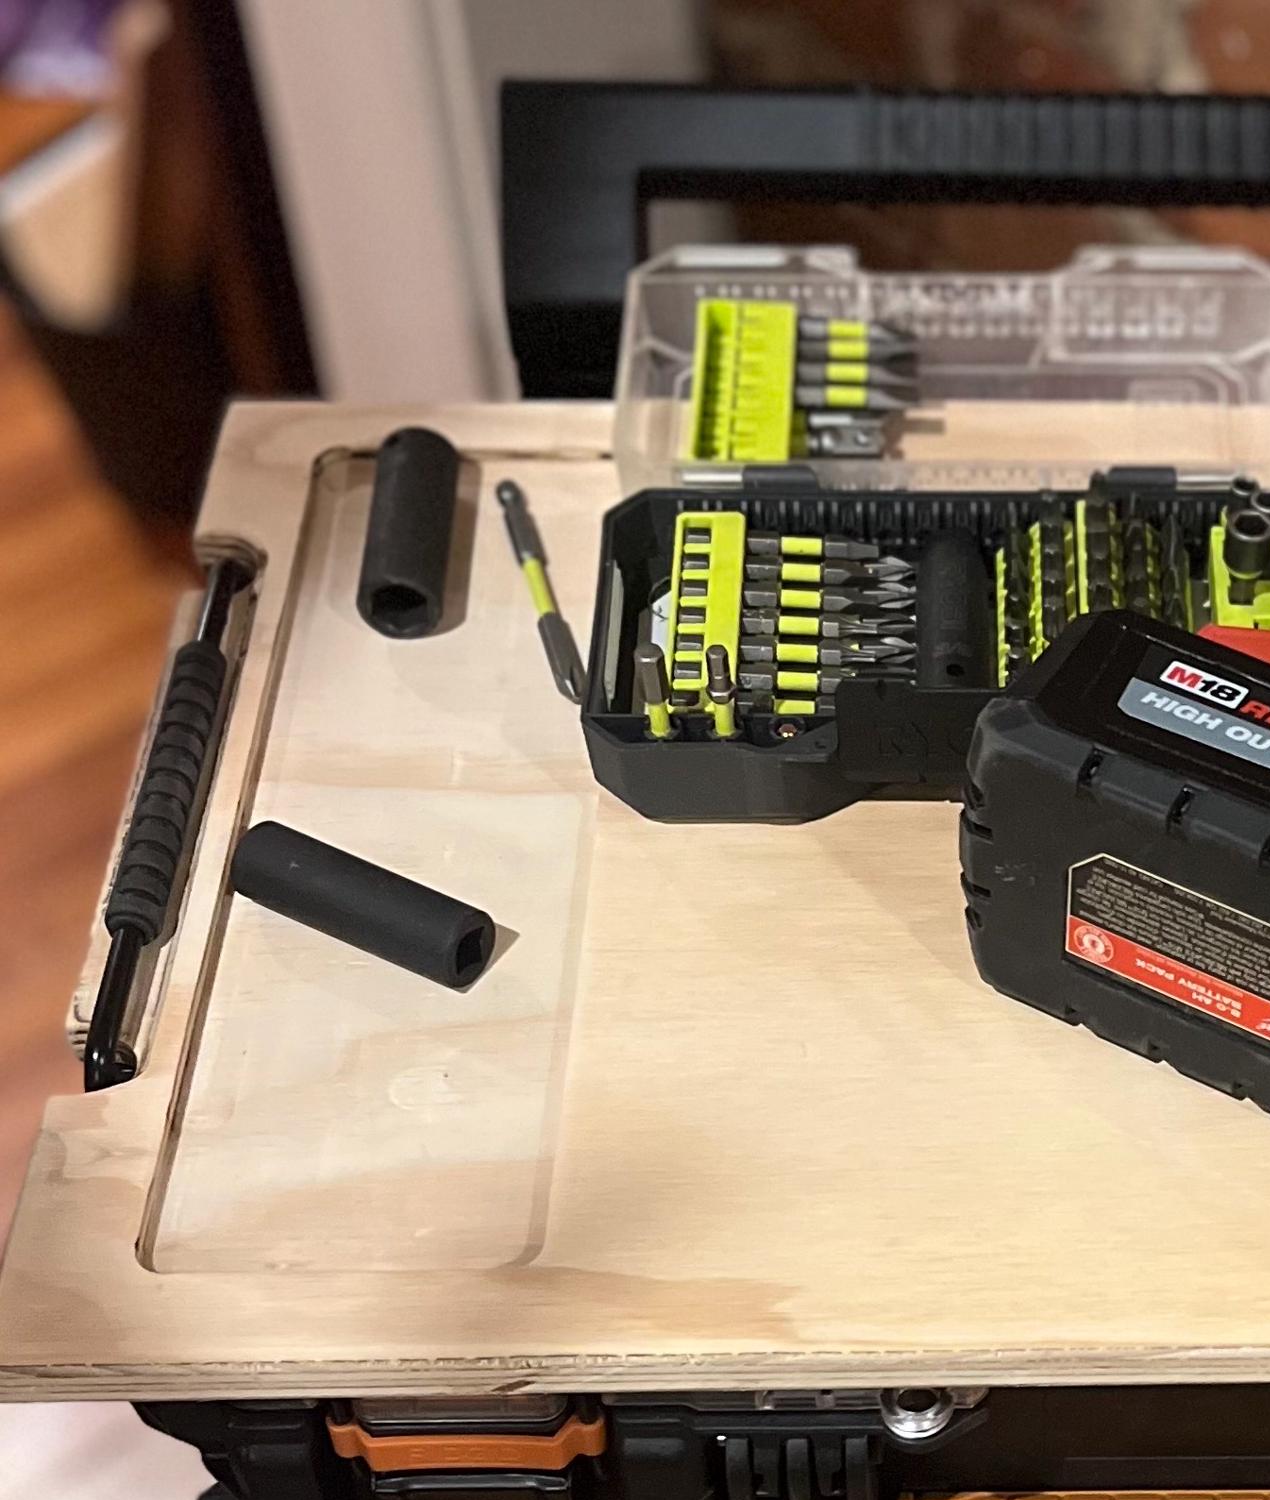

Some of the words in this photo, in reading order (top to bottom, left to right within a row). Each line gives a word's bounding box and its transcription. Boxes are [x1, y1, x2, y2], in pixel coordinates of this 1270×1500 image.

[1166, 665, 1242, 702] M18
[1140, 691, 1223, 731] HIGH
[1135, 957, 1177, 982] PACK
[1178, 976, 1243, 1010] BATTERY
